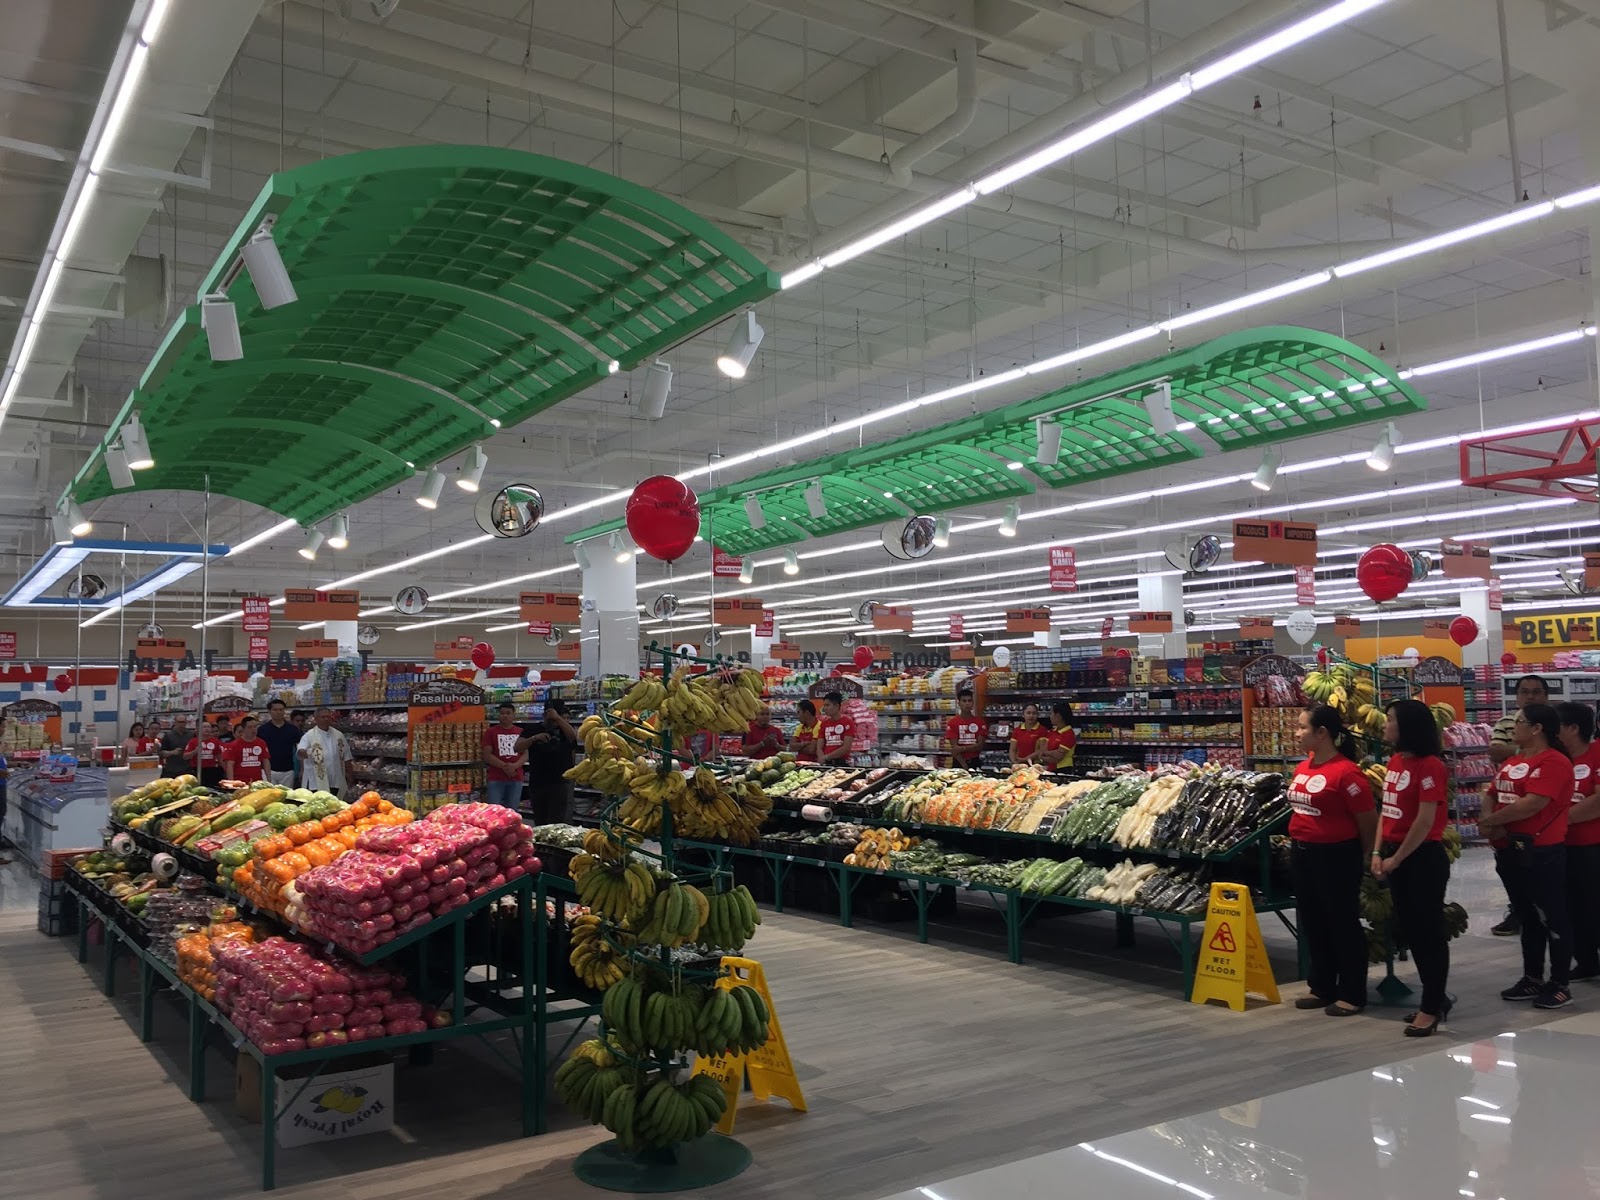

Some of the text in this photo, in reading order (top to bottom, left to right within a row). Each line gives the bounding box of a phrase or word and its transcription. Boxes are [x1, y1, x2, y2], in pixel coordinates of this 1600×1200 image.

[1239, 525, 1266, 536] PRODUCE
[1521, 616, 1600, 645] BEVE
[248, 650, 373, 673] MART
[868, 652, 951, 670] EAFOODS
[413, 693, 480, 705] Pasalubong
[1211, 907, 1242, 917] CAUTION
[1212, 956, 1231, 965] WET
[1205, 965, 1236, 976] FLOOR
[709, 1058, 728, 1070] WET
[701, 1069, 731, 1084] FOOR
[293, 1099, 386, 1136] Royal Fresh
